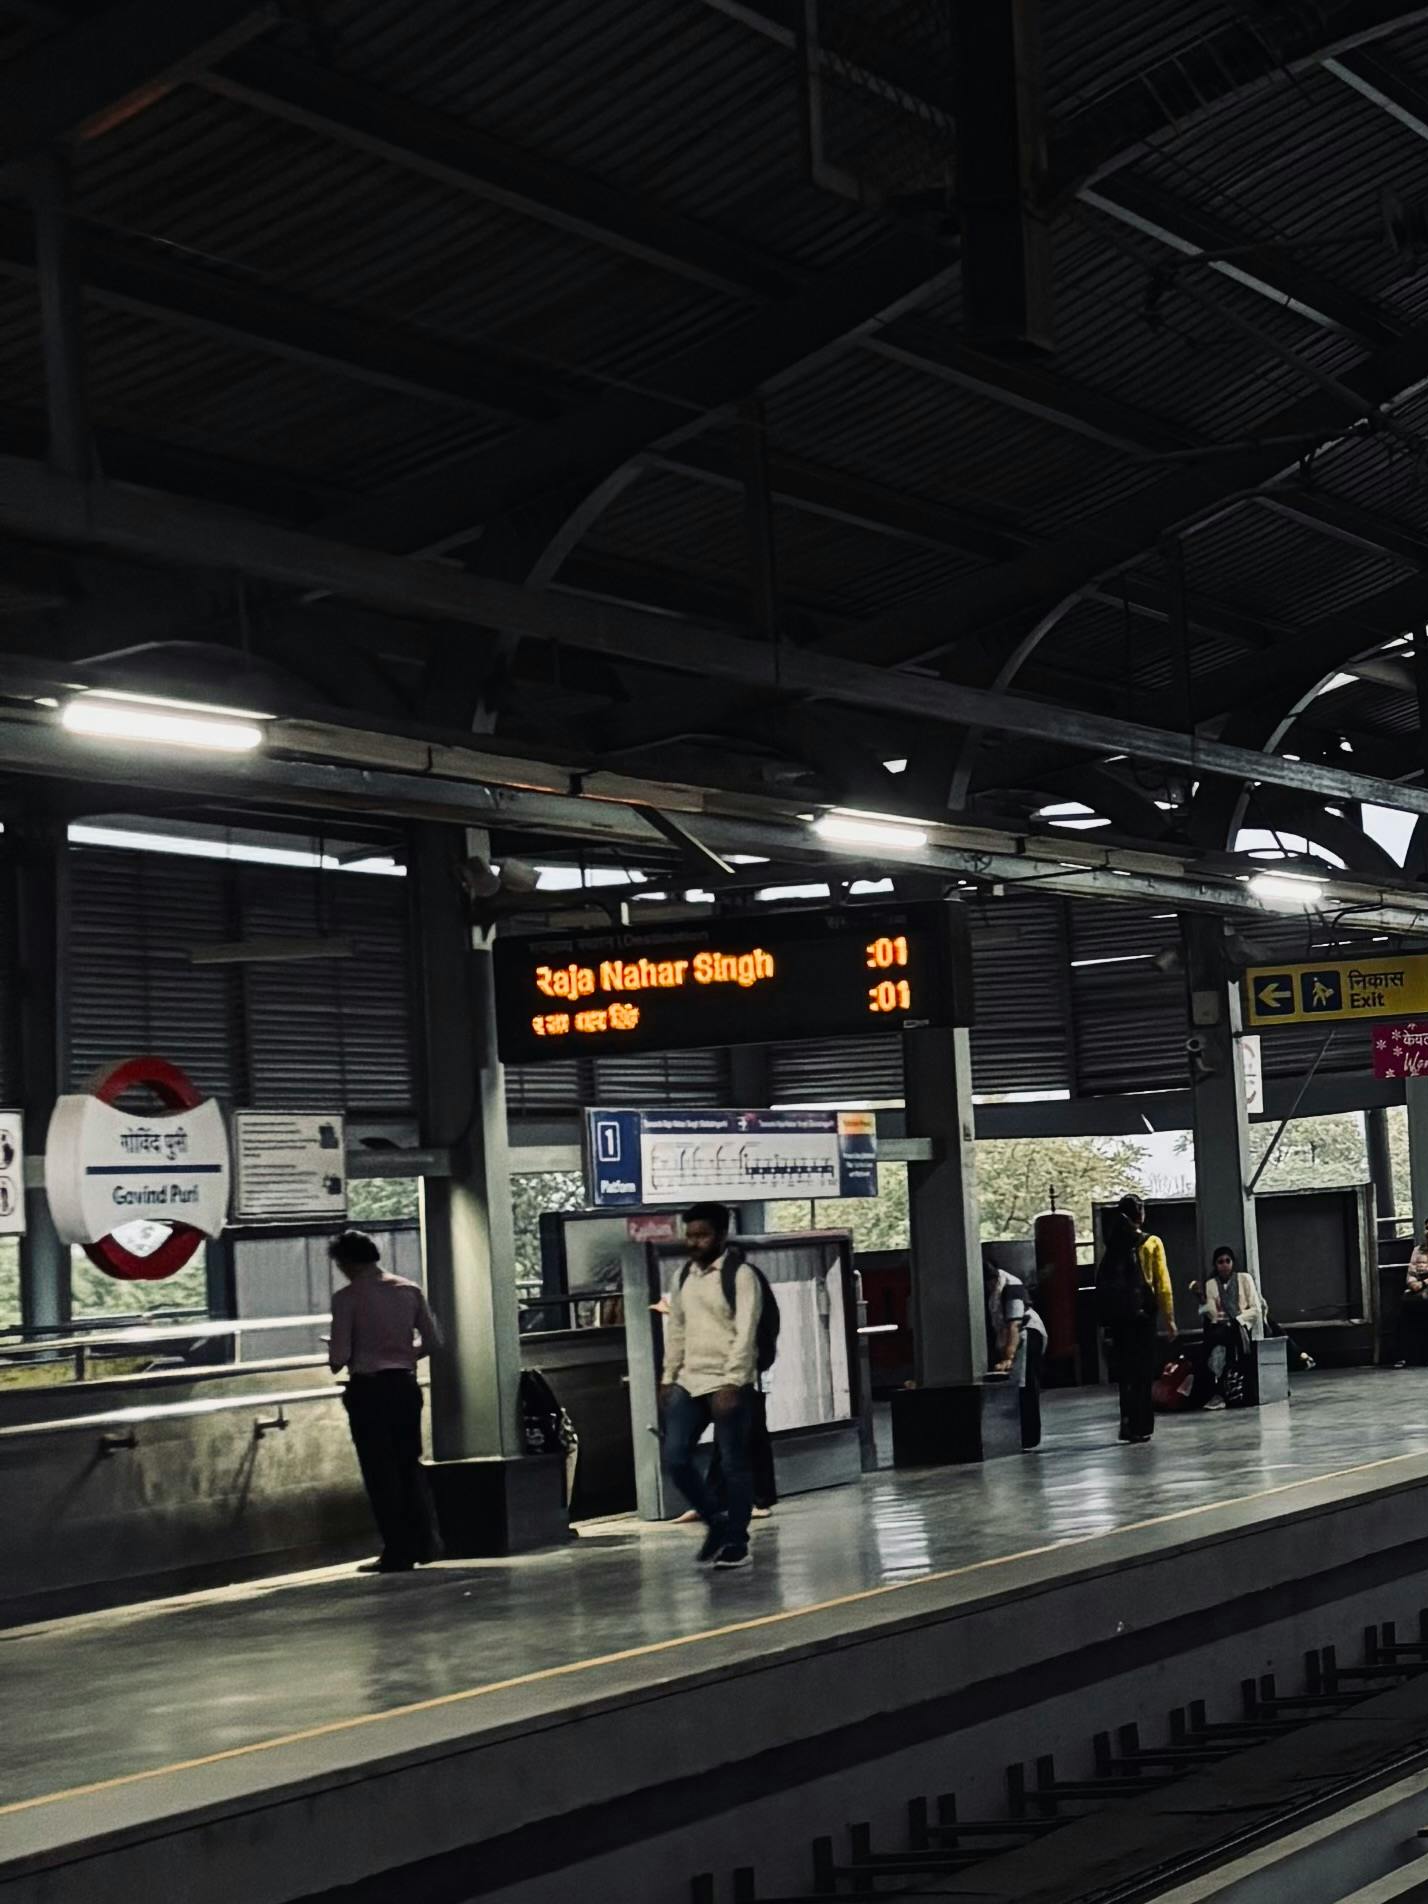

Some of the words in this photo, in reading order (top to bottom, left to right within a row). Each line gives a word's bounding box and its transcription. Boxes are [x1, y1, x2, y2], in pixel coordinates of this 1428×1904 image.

[536, 964, 595, 1001] Raja
[600, 958, 689, 991] Nahar
[693, 947, 775, 988] Singh
[1347, 969, 1405, 992] निकास
[1350, 991, 1385, 1009] Exit
[604, 1128, 616, 1156] 1
[112, 1185, 168, 1205] Govind
[170, 1184, 200, 1204] Puri
